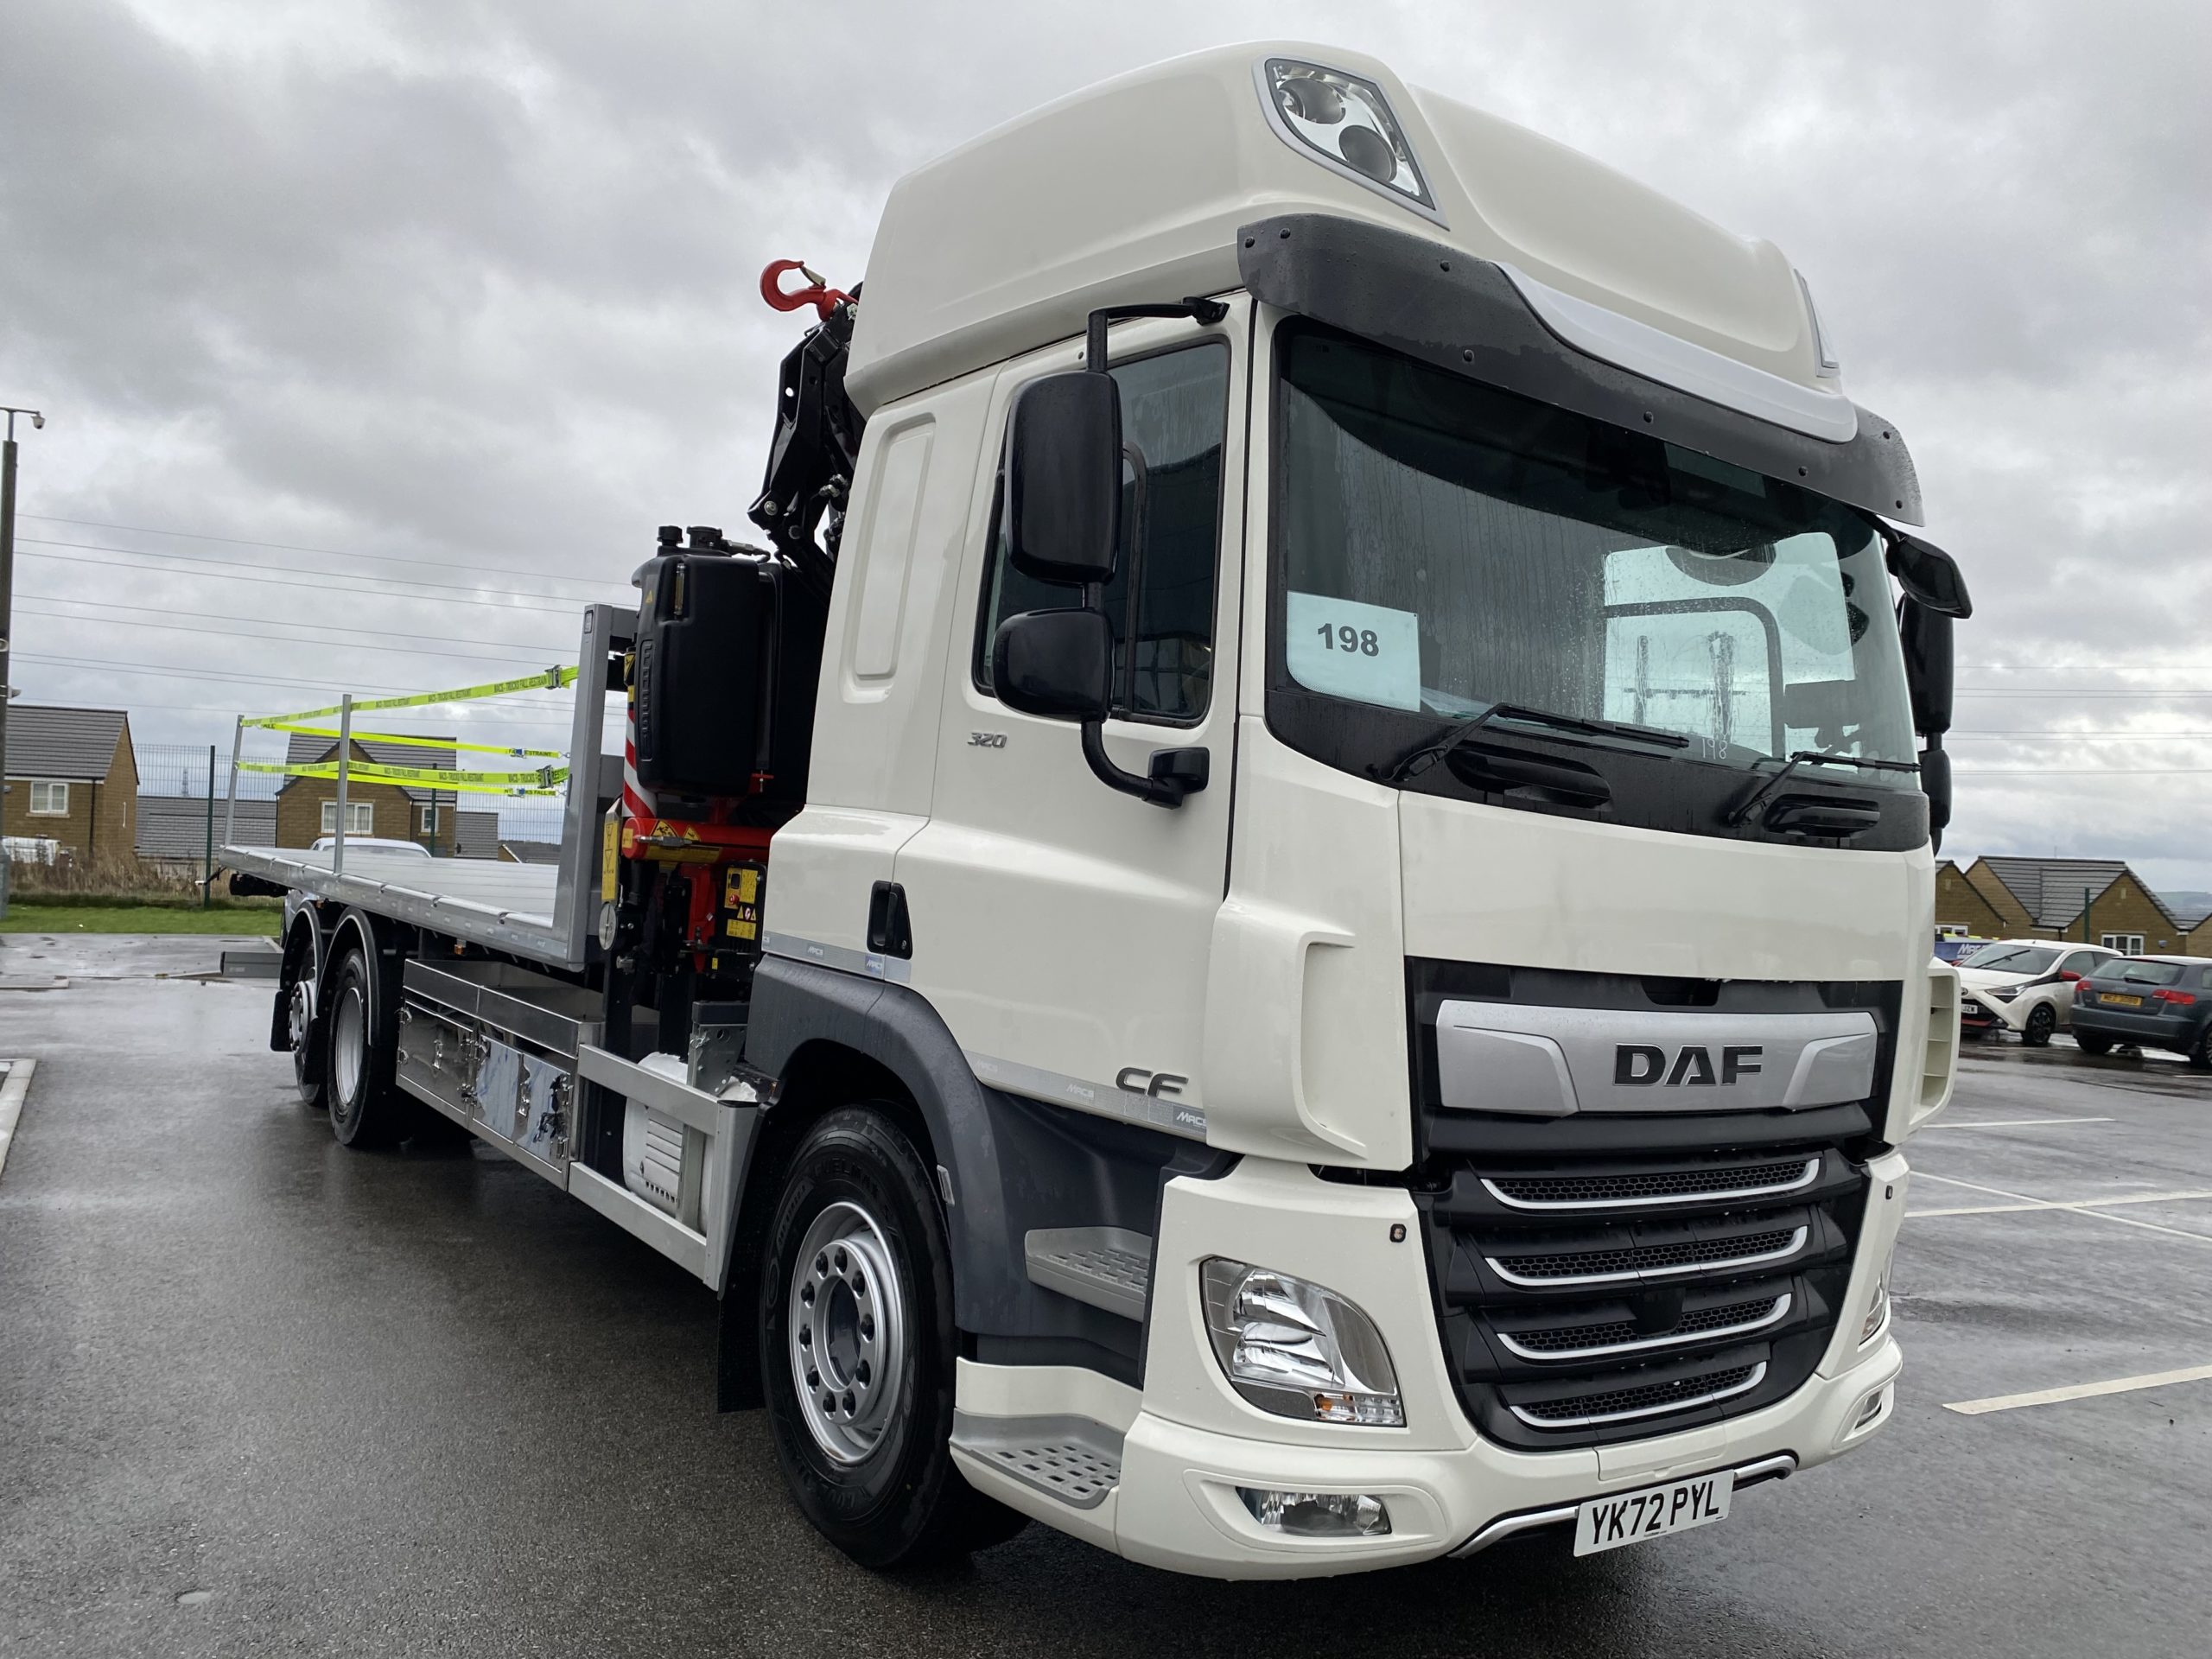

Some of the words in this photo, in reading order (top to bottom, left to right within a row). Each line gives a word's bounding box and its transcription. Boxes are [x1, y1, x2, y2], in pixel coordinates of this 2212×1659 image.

[1318, 622, 1379, 657] 198
[968, 732, 1007, 748] 320
[1702, 738, 1727, 760] 198
[1613, 1043, 1763, 1086] DAF
[1065, 1084, 1095, 1100] MACS
[1116, 1066, 1189, 1097] CF
[1592, 1492, 1665, 1545] YK72
[1669, 1480, 1719, 1526] PYL
